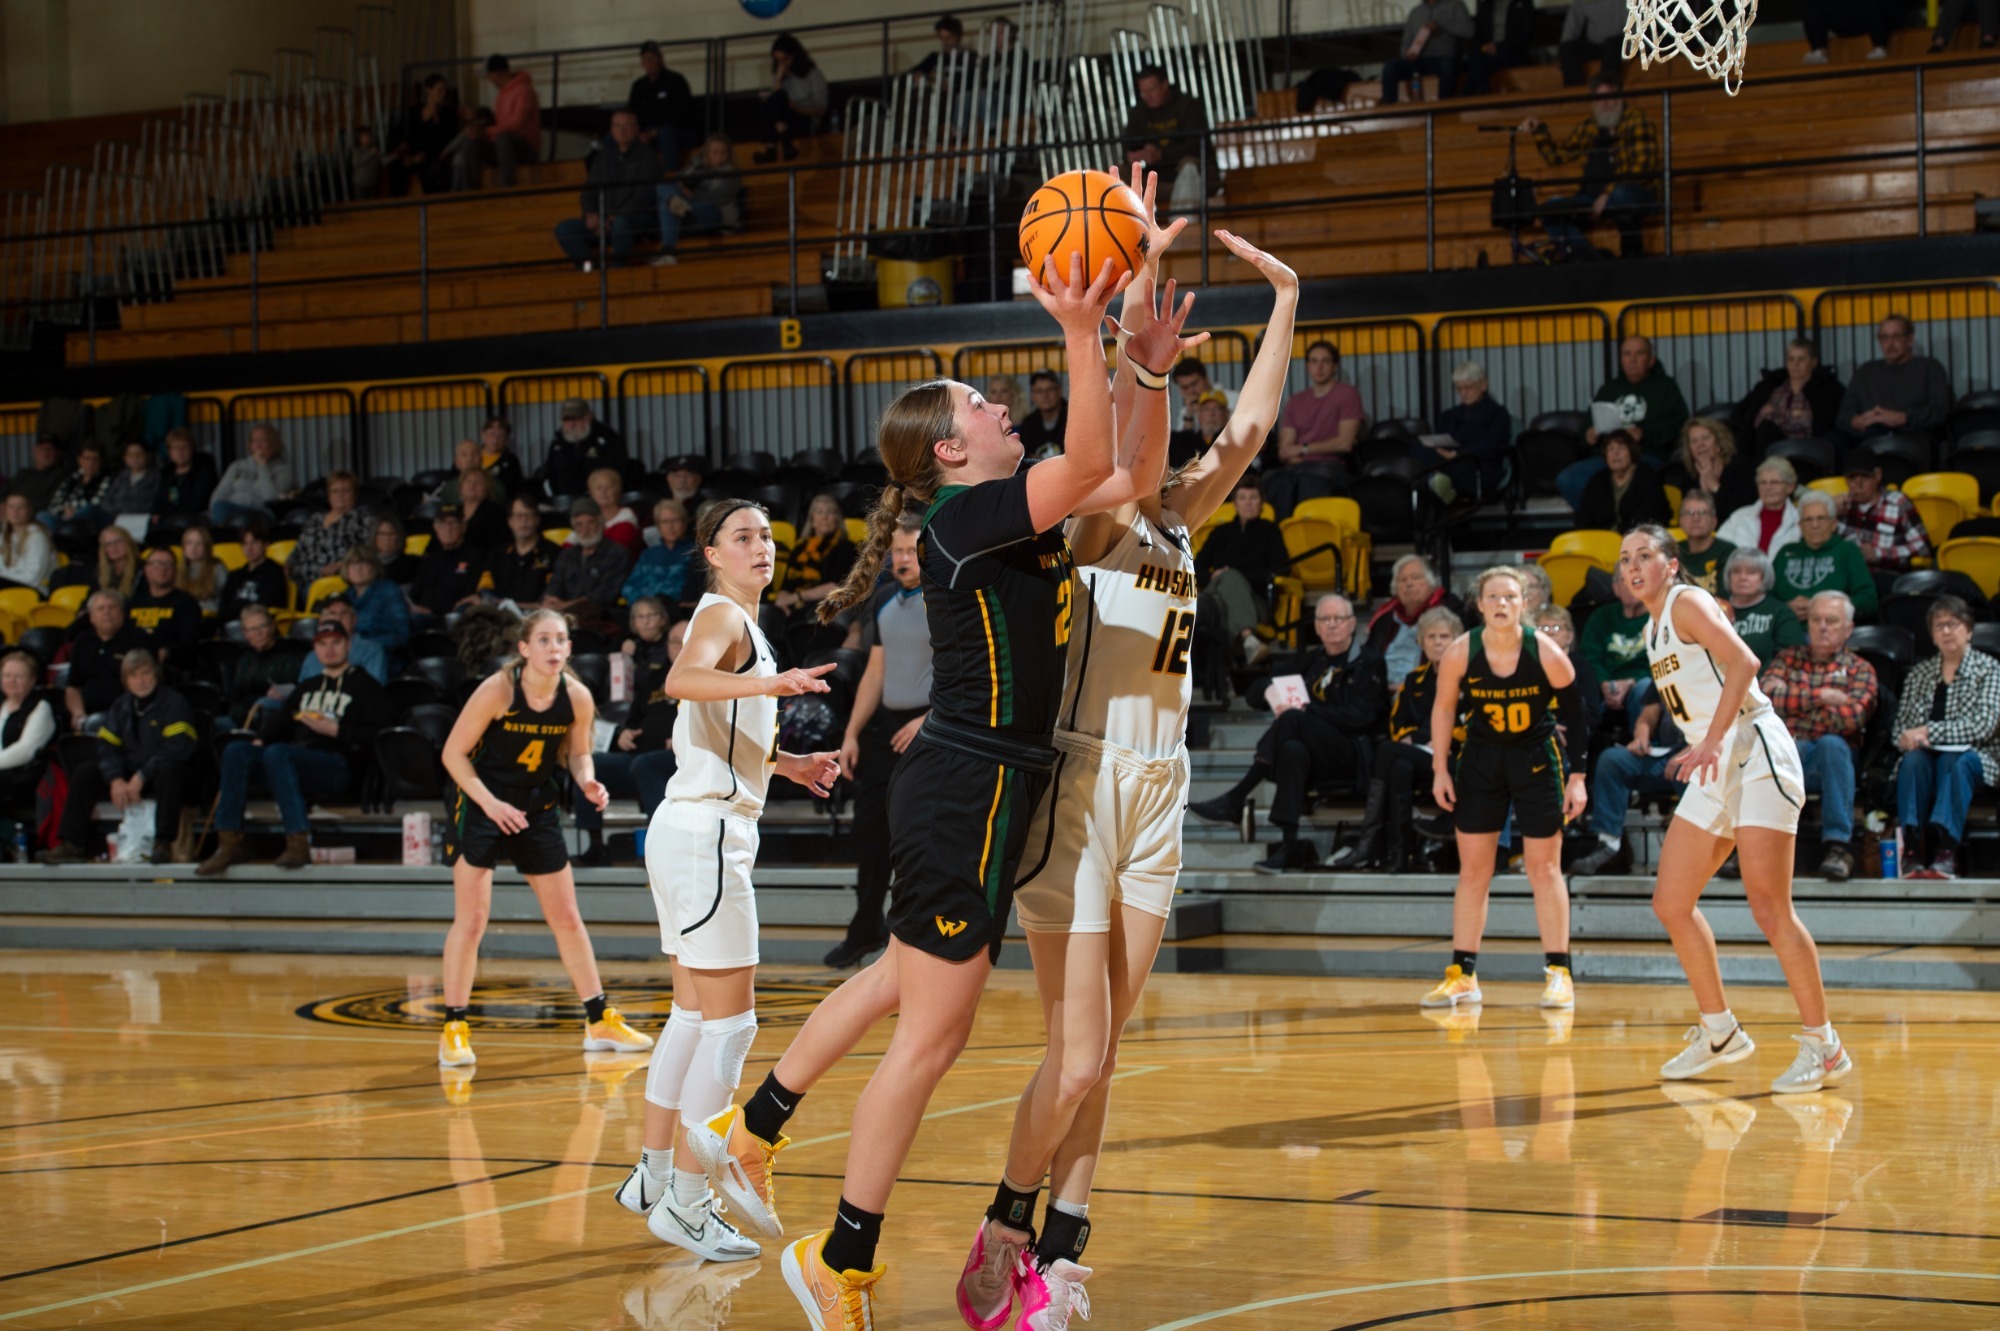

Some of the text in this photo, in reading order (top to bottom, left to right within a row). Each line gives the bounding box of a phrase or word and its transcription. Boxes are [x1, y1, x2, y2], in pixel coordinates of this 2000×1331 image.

[780, 318, 803, 349] B
[1150, 607, 1195, 677] 12
[1470, 685, 1540, 699] WAYNE STATE
[502, 720, 539, 734] WAYNE
[1482, 702, 1531, 734] 30
[516, 739, 545, 773] 4
